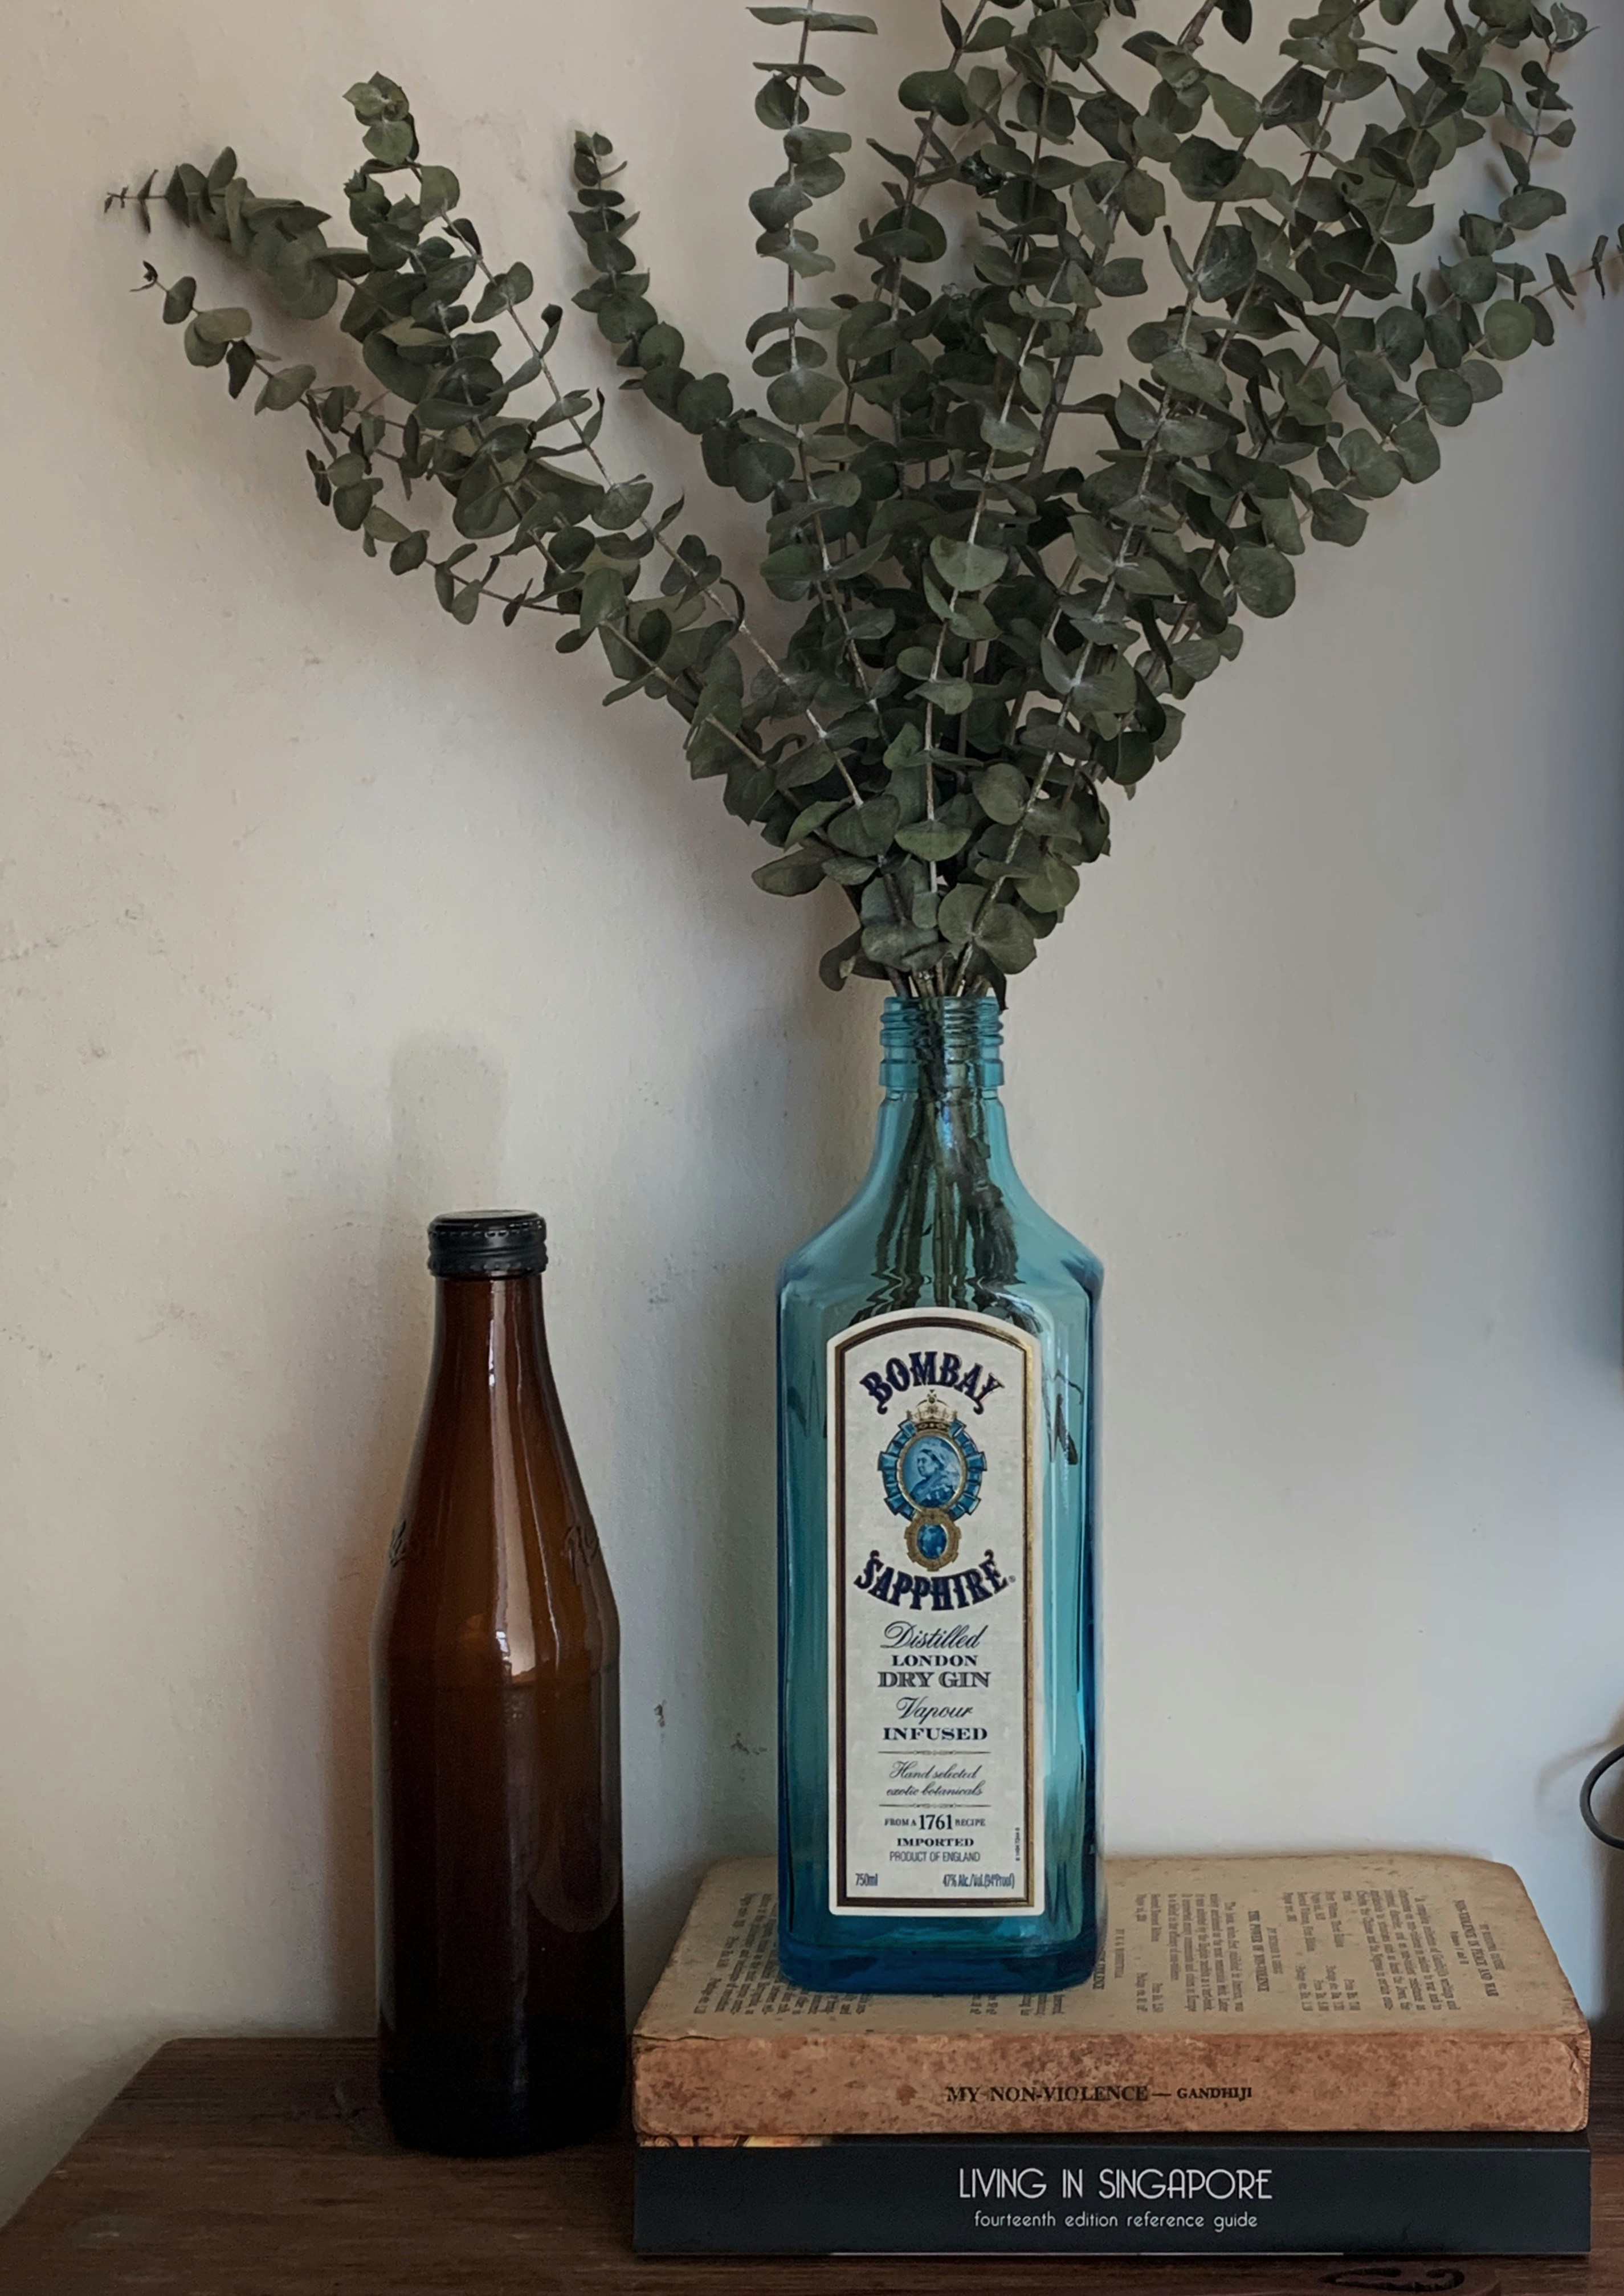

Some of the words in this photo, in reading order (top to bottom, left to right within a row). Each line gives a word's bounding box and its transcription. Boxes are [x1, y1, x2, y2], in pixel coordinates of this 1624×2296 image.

[858, 1351, 1005, 1414] BOMBAY
[853, 1549, 1009, 1611] SAPPHIRE
[879, 1620, 989, 1649] Distilled
[891, 1654, 978, 1667] LONDON
[878, 1671, 935, 1688] DRY
[938, 1671, 992, 1688] GIN
[896, 1696, 973, 1725] Vapour
[882, 1727, 988, 1741] INFUSED
[888, 1760, 936, 1779] Hand
[932, 1764, 983, 1779] selected
[886, 1784, 920, 1796] exotic
[920, 1780, 986, 1796] botanicals
[884, 1818, 909, 1826] FROM
[919, 1814, 953, 1830] 1761
[955, 1818, 986, 1826] RECIPE
[897, 1837, 974, 1847] IMPORTED
[889, 1850, 928, 1862] PRODUCT
[929, 1851, 941, 1862] OF
[942, 1851, 981, 1862] ENGLAND
[855, 1873, 879, 1887] 750ml
[946, 2086, 980, 2102] MY
[990, 2086, 1148, 2102] NON-VIOLENCE
[1177, 2087, 1252, 2101] GANDHIJI
[960, 2168, 1047, 2199] LIVING
[1062, 2168, 1083, 2199] IN
[1098, 2168, 1273, 2200] SINGAPORE
[974, 2210, 1056, 2227] fourteenth
[1064, 2211, 1118, 2227] edition
[1127, 2211, 1205, 2228] reference
[1213, 2211, 1258, 2233] guide
